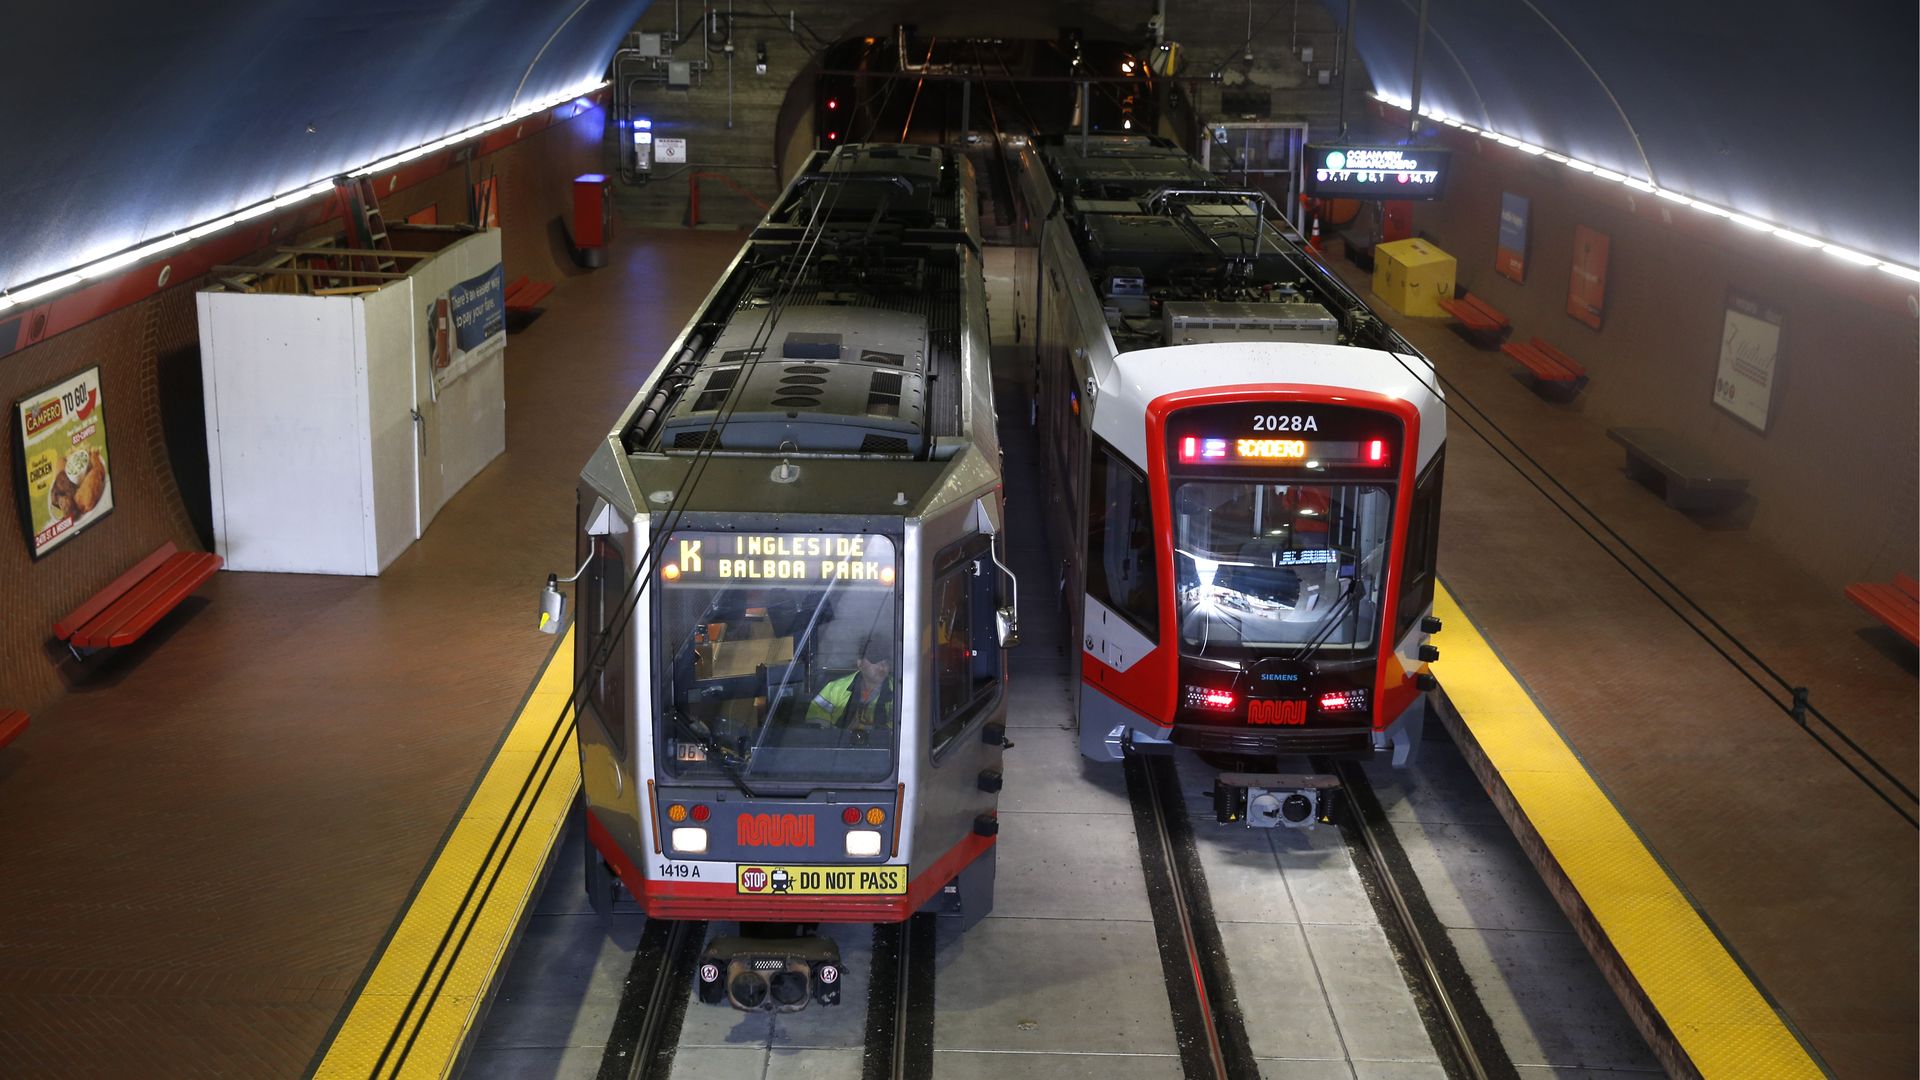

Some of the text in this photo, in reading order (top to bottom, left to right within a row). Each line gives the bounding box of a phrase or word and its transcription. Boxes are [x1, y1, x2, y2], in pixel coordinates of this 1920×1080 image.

[451, 290, 469, 310] There's
[462, 311, 472, 329] pay
[62, 382, 87, 415] TO GO!
[26, 404, 62, 432] CAMPERO
[1253, 415, 1318, 432] 2028A
[30, 462, 52, 483] CHICKEN
[680, 540, 701, 571] K
[737, 536, 864, 557] INGLESIDE
[719, 560, 879, 580] BALBOA PARK
[1260, 673, 1298, 681] SIEMENS
[659, 864, 700, 878] 1419 A
[744, 872, 766, 888] STOP
[800, 872, 821, 890] DO
[825, 872, 855, 890] NOT
[860, 872, 898, 890] PASS
